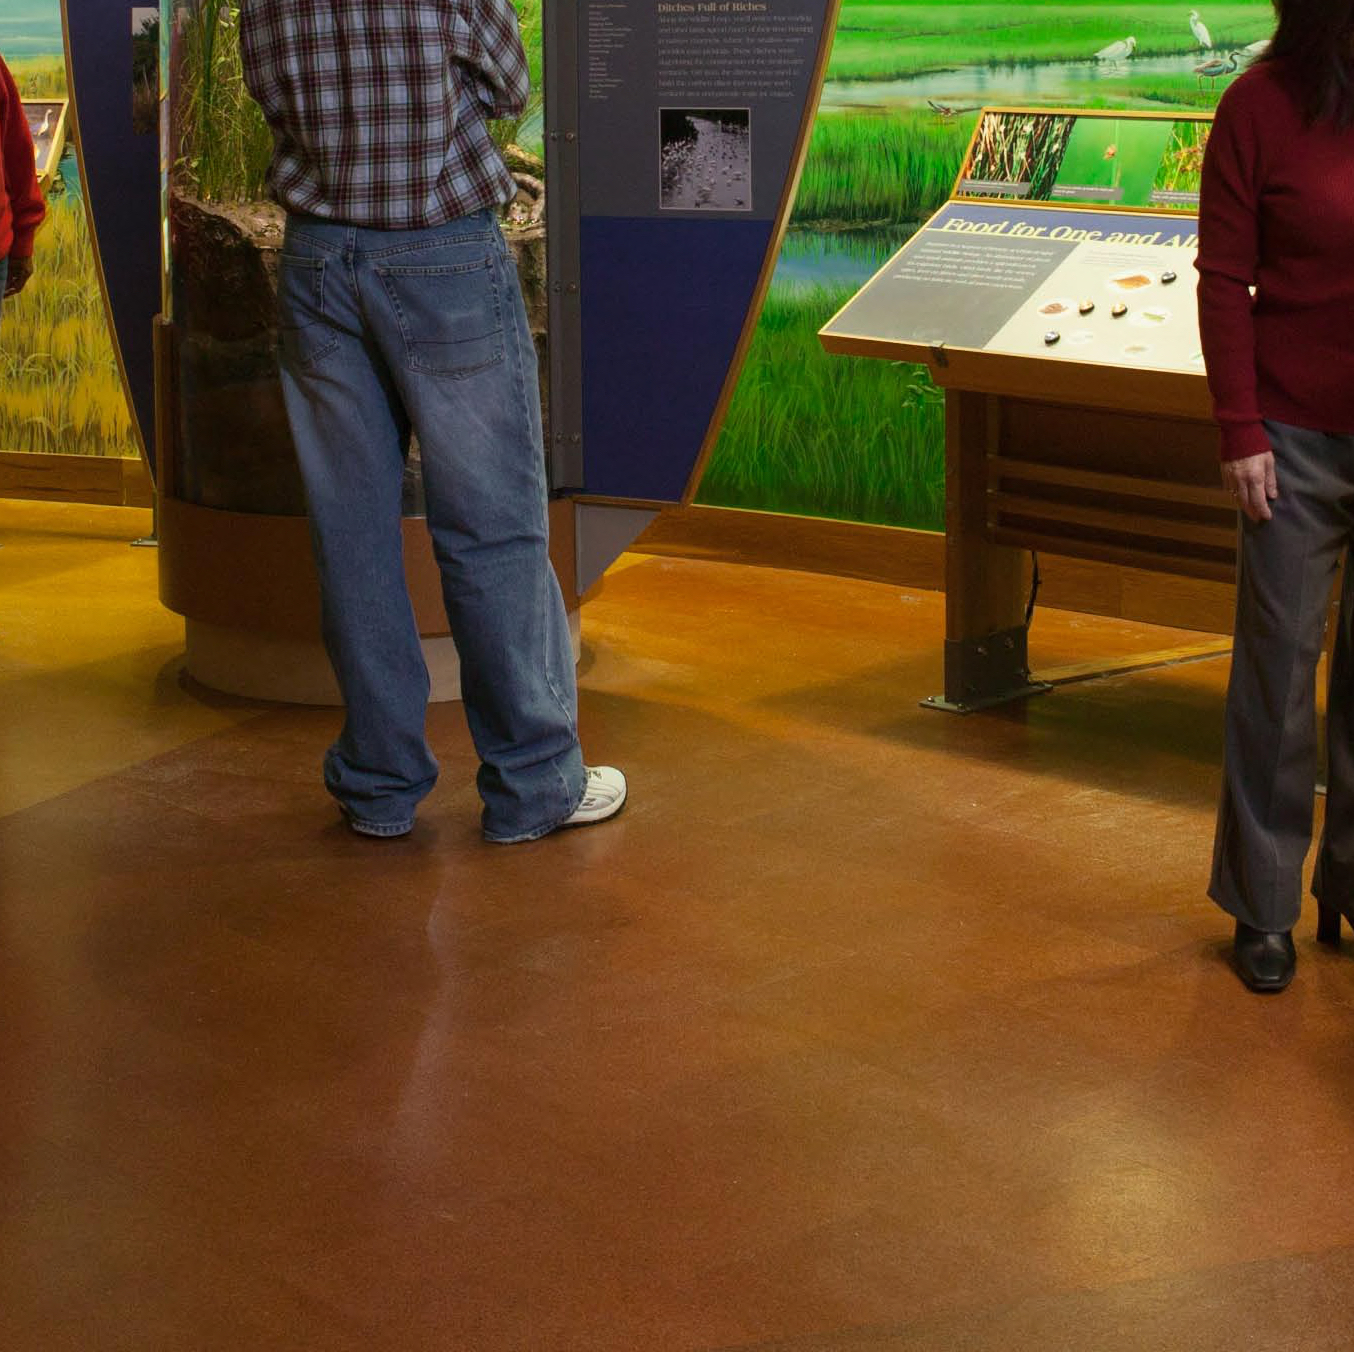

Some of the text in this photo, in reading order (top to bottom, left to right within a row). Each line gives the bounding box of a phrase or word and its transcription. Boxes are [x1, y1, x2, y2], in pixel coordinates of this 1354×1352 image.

[942, 218, 1008, 236] Food
[1007, 221, 1046, 238] for
[1049, 226, 1102, 242] One
[1105, 232, 1158, 248] and
